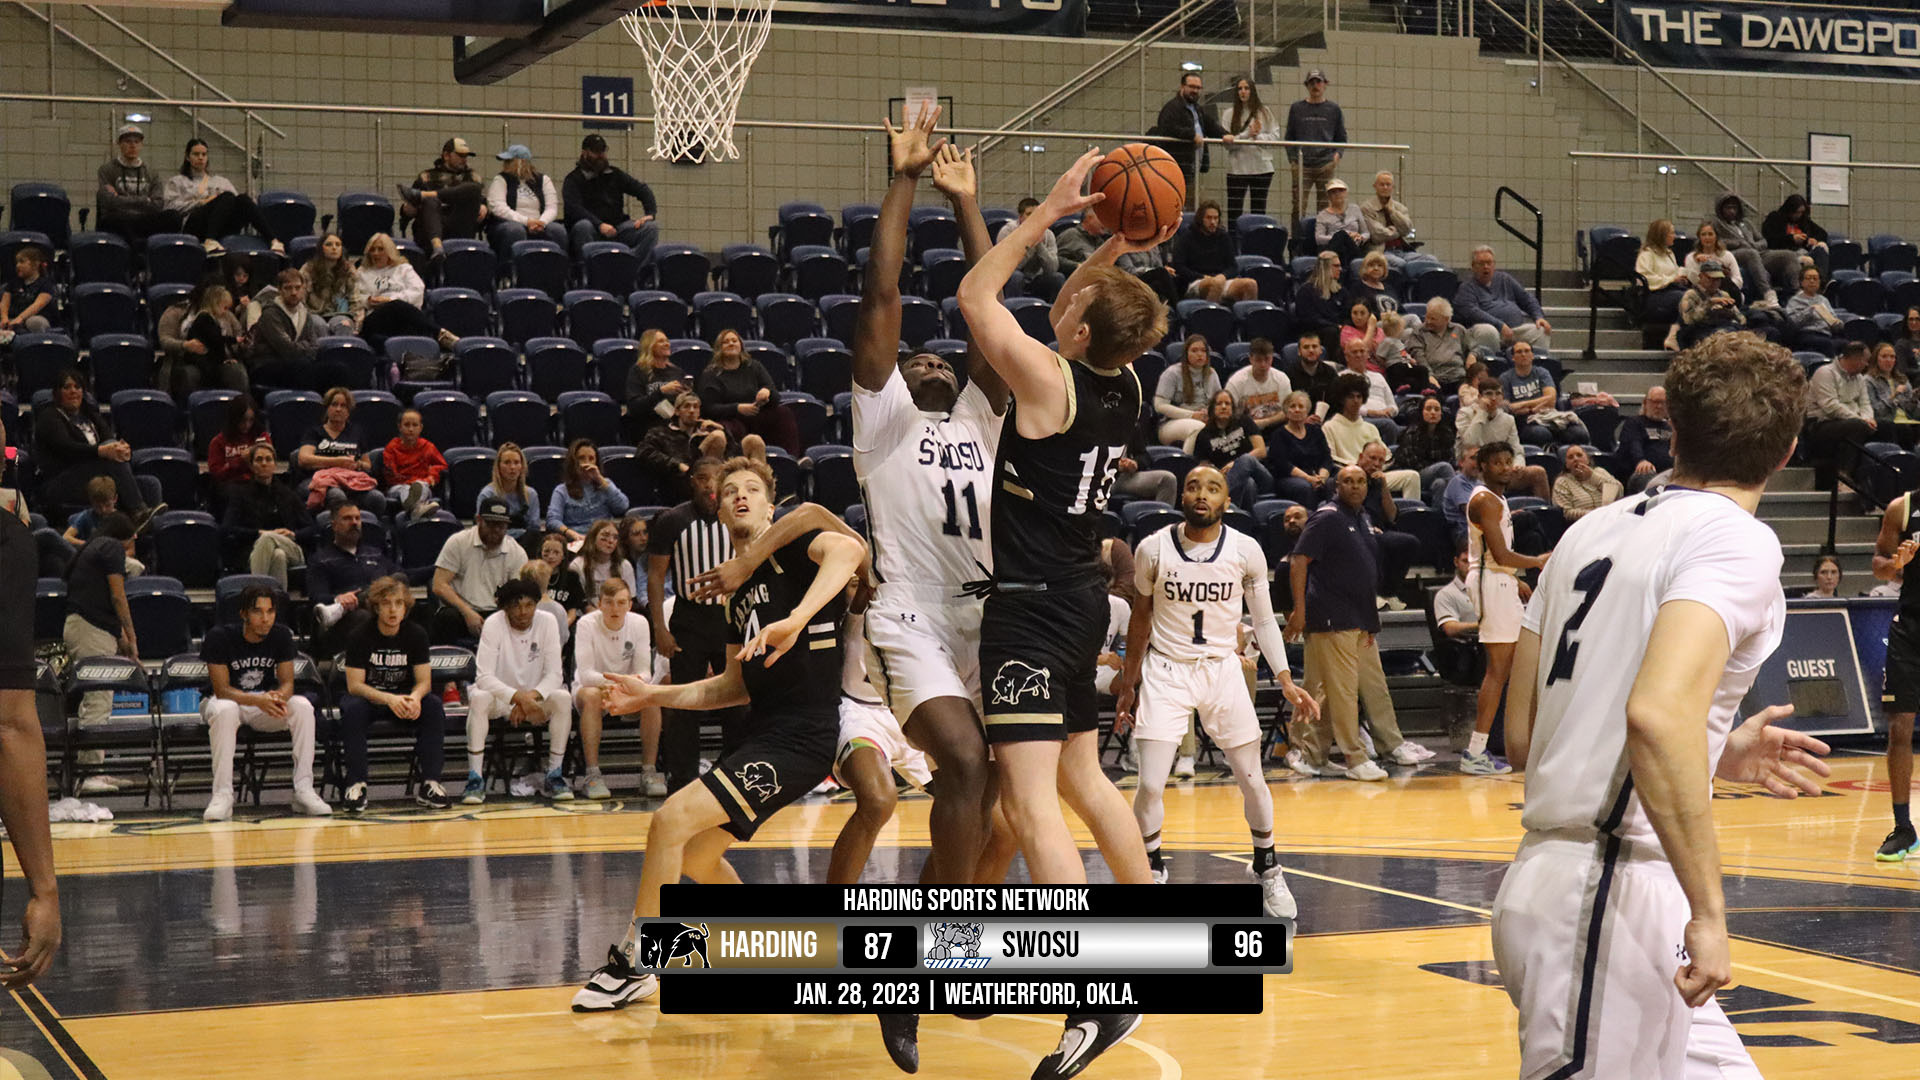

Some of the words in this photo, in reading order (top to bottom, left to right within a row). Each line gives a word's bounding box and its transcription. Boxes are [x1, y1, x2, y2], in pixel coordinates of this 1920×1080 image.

[1630, 7, 1722, 46] THE
[590, 91, 628, 115] 111
[1067, 444, 1127, 516] 15
[941, 479, 983, 540] 11
[1164, 581, 1234, 603] SWOSU
[1191, 610, 1208, 645] 1
[1545, 556, 1613, 689] 2
[78, 666, 134, 680] SWOSU
[169, 663, 209, 676] SWOS
[231, 656, 275, 671] SWOSU
[430, 656, 469, 668] WOSU
[1787, 659, 1836, 678] GUEST
